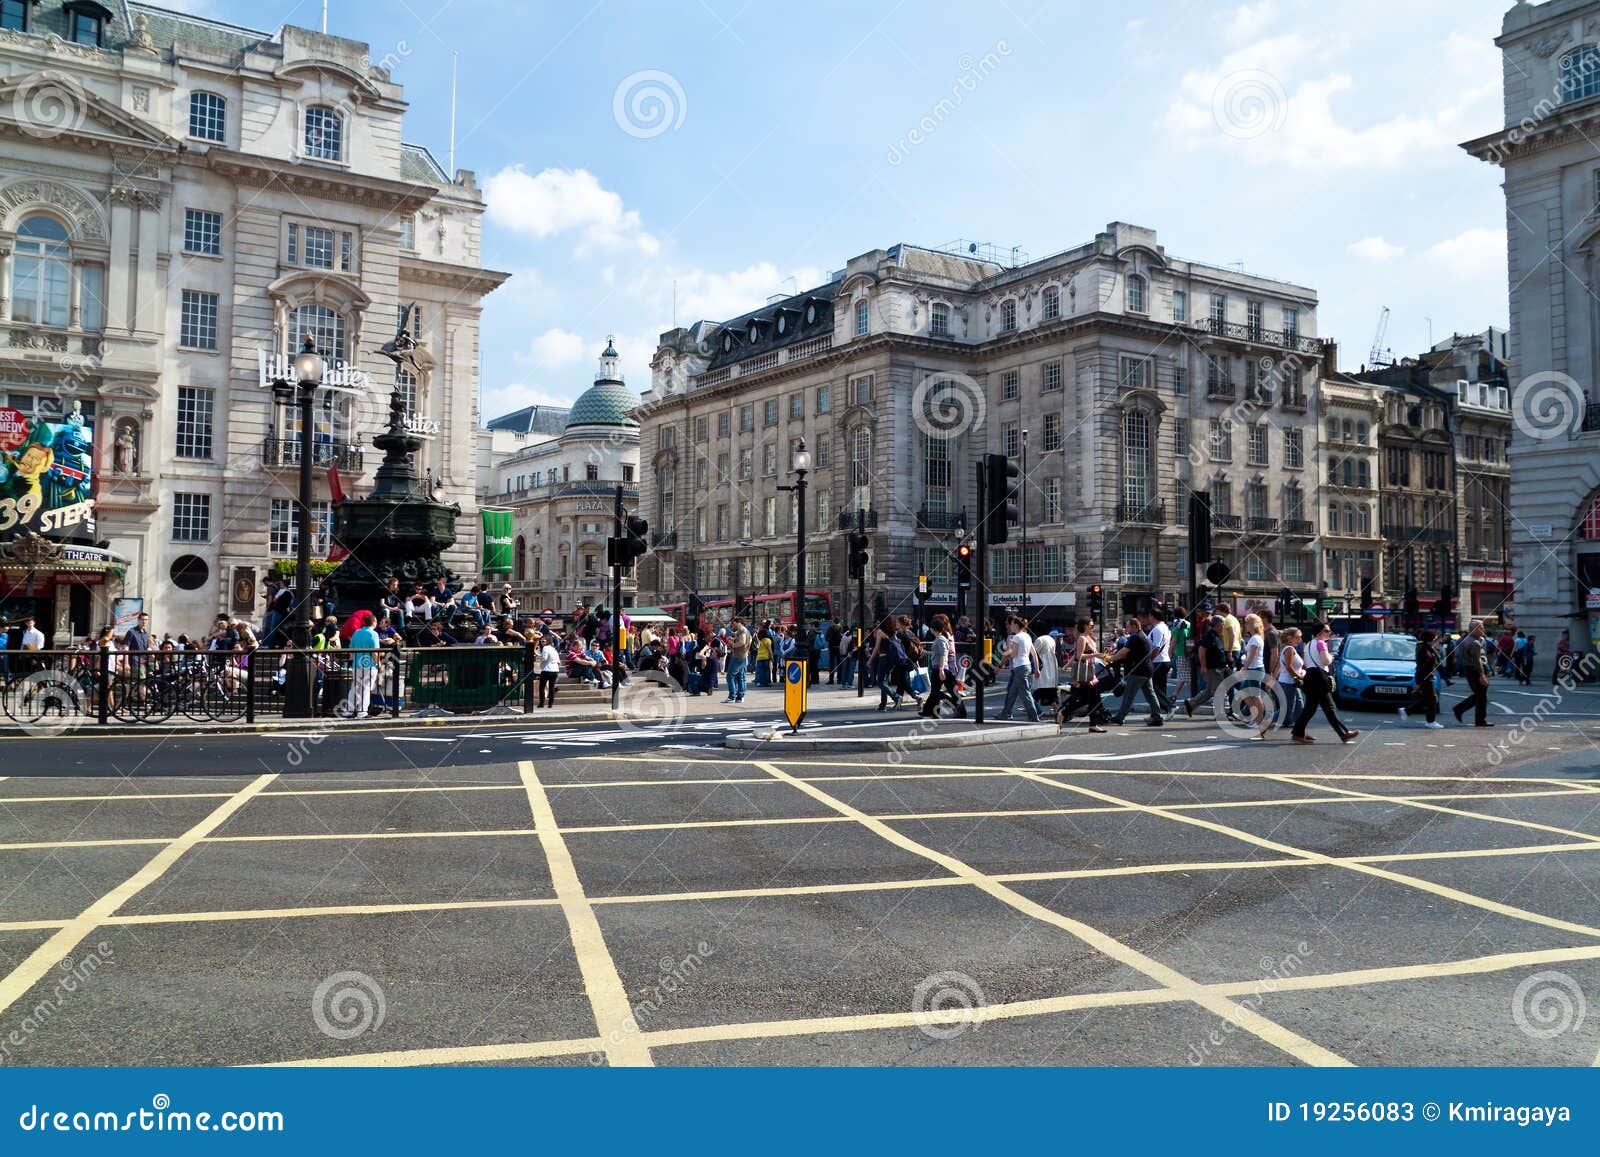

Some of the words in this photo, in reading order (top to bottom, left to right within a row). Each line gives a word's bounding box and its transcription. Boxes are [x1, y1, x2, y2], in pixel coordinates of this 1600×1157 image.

[258, 348, 370, 388] Lillhites
[0, 493, 42, 531] 39
[40, 499, 96, 533] STEPS
[575, 501, 604, 511] PLAZA
[66, 550, 103, 561] THEATRE
